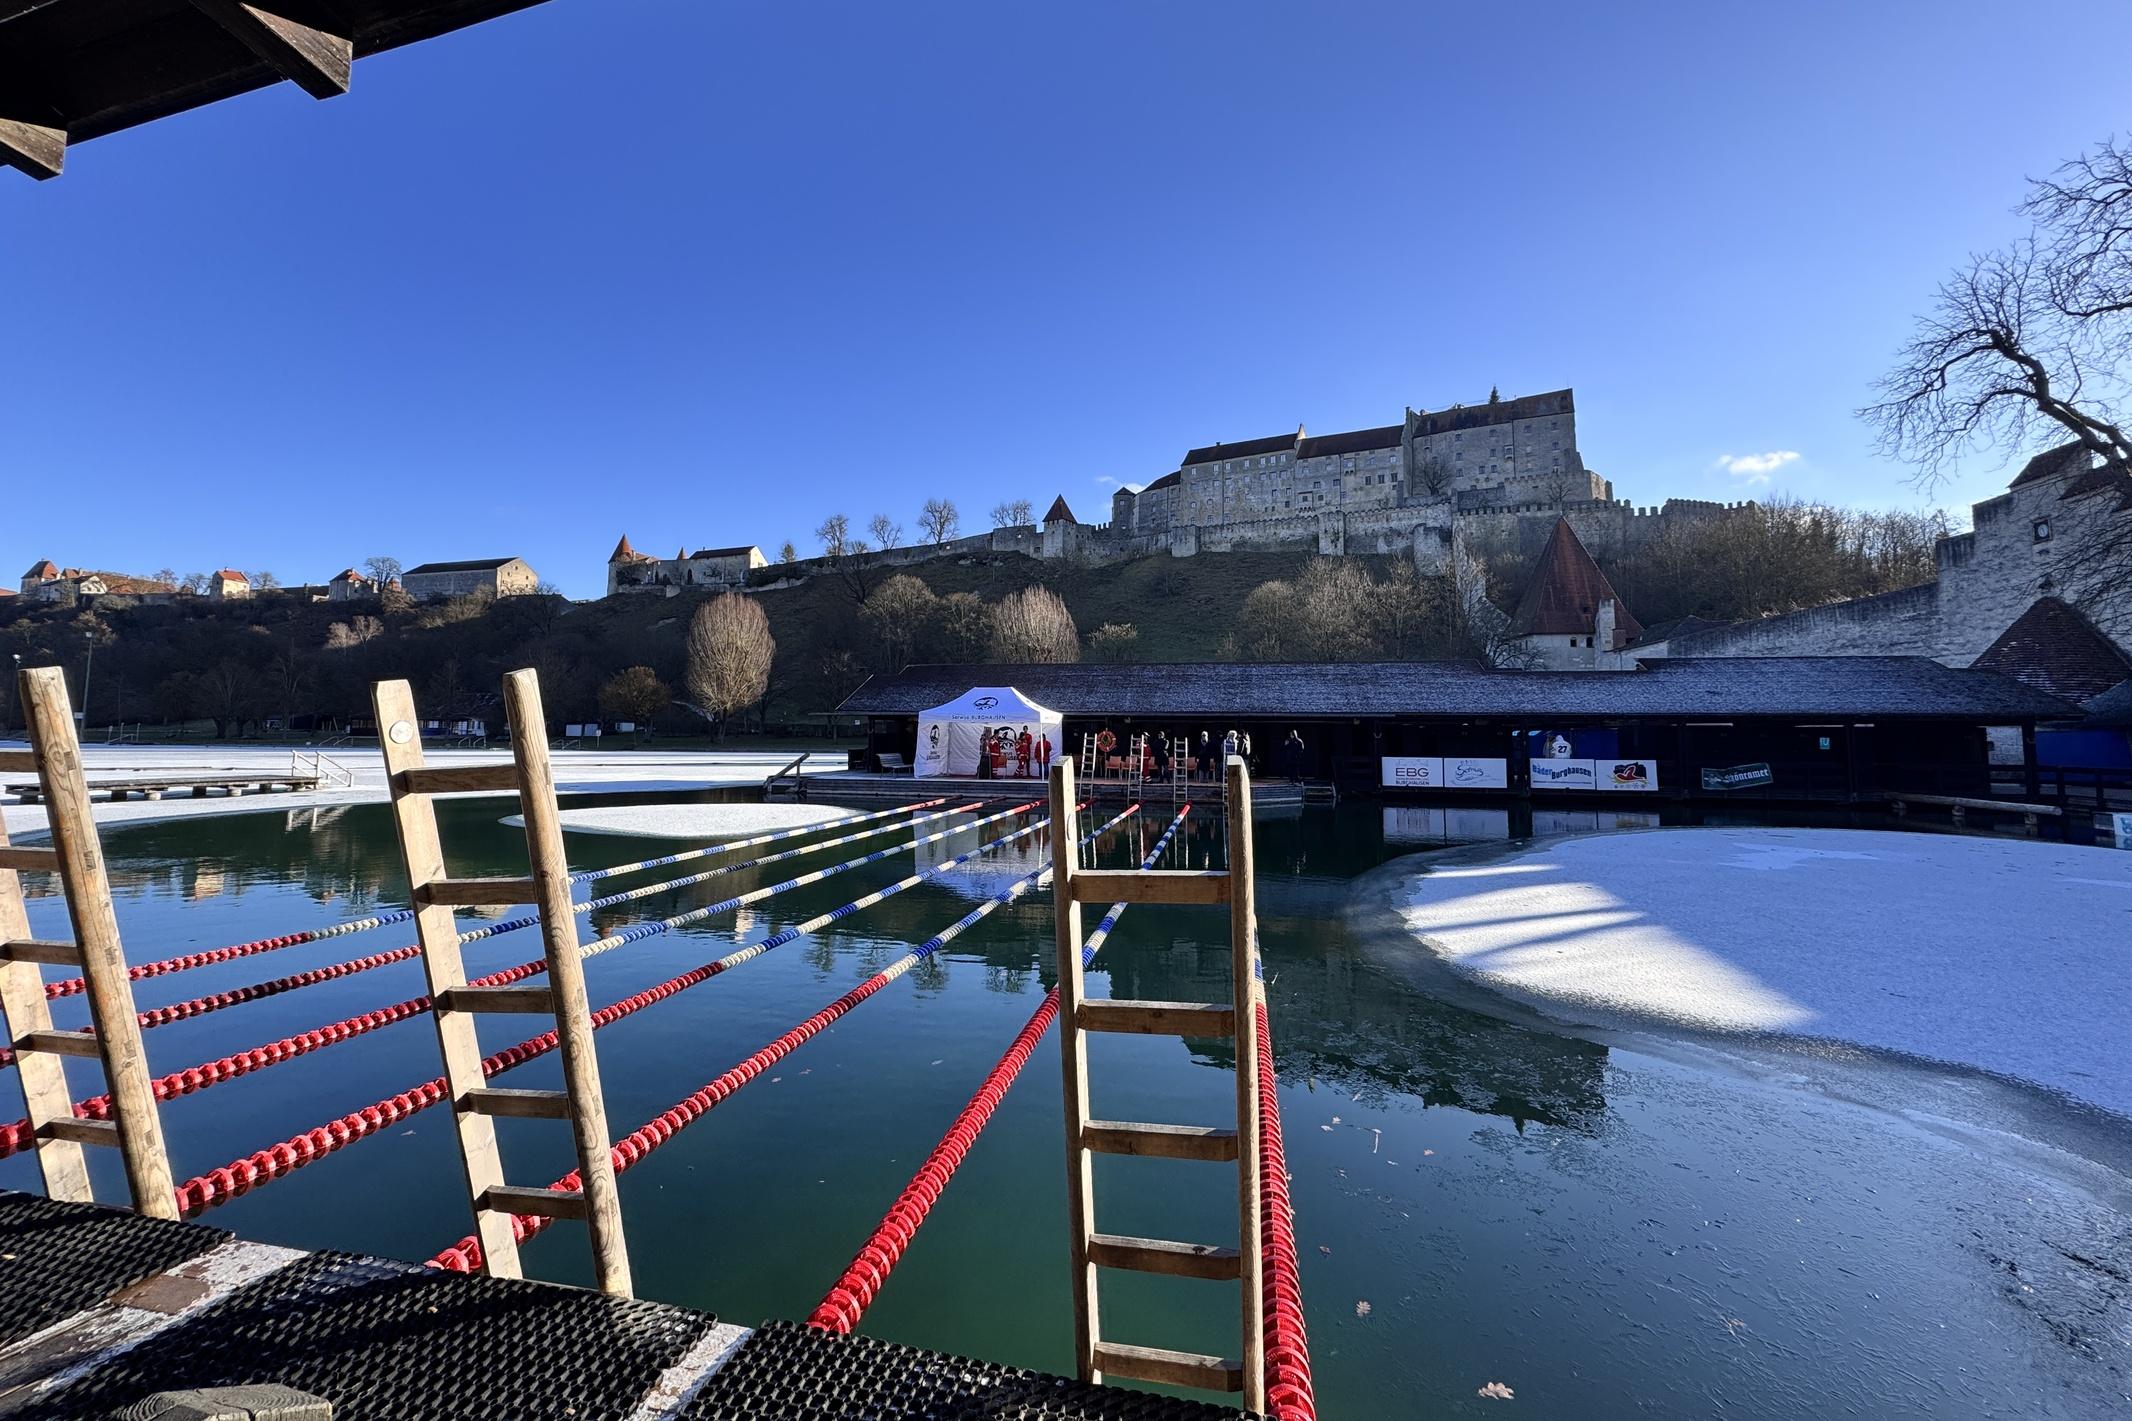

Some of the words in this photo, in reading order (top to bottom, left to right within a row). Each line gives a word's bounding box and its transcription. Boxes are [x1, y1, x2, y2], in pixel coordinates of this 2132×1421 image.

[1557, 745, 1567, 753] 27
[1396, 767, 1429, 777] EBG
[1551, 767, 1592, 780] Burghausen
